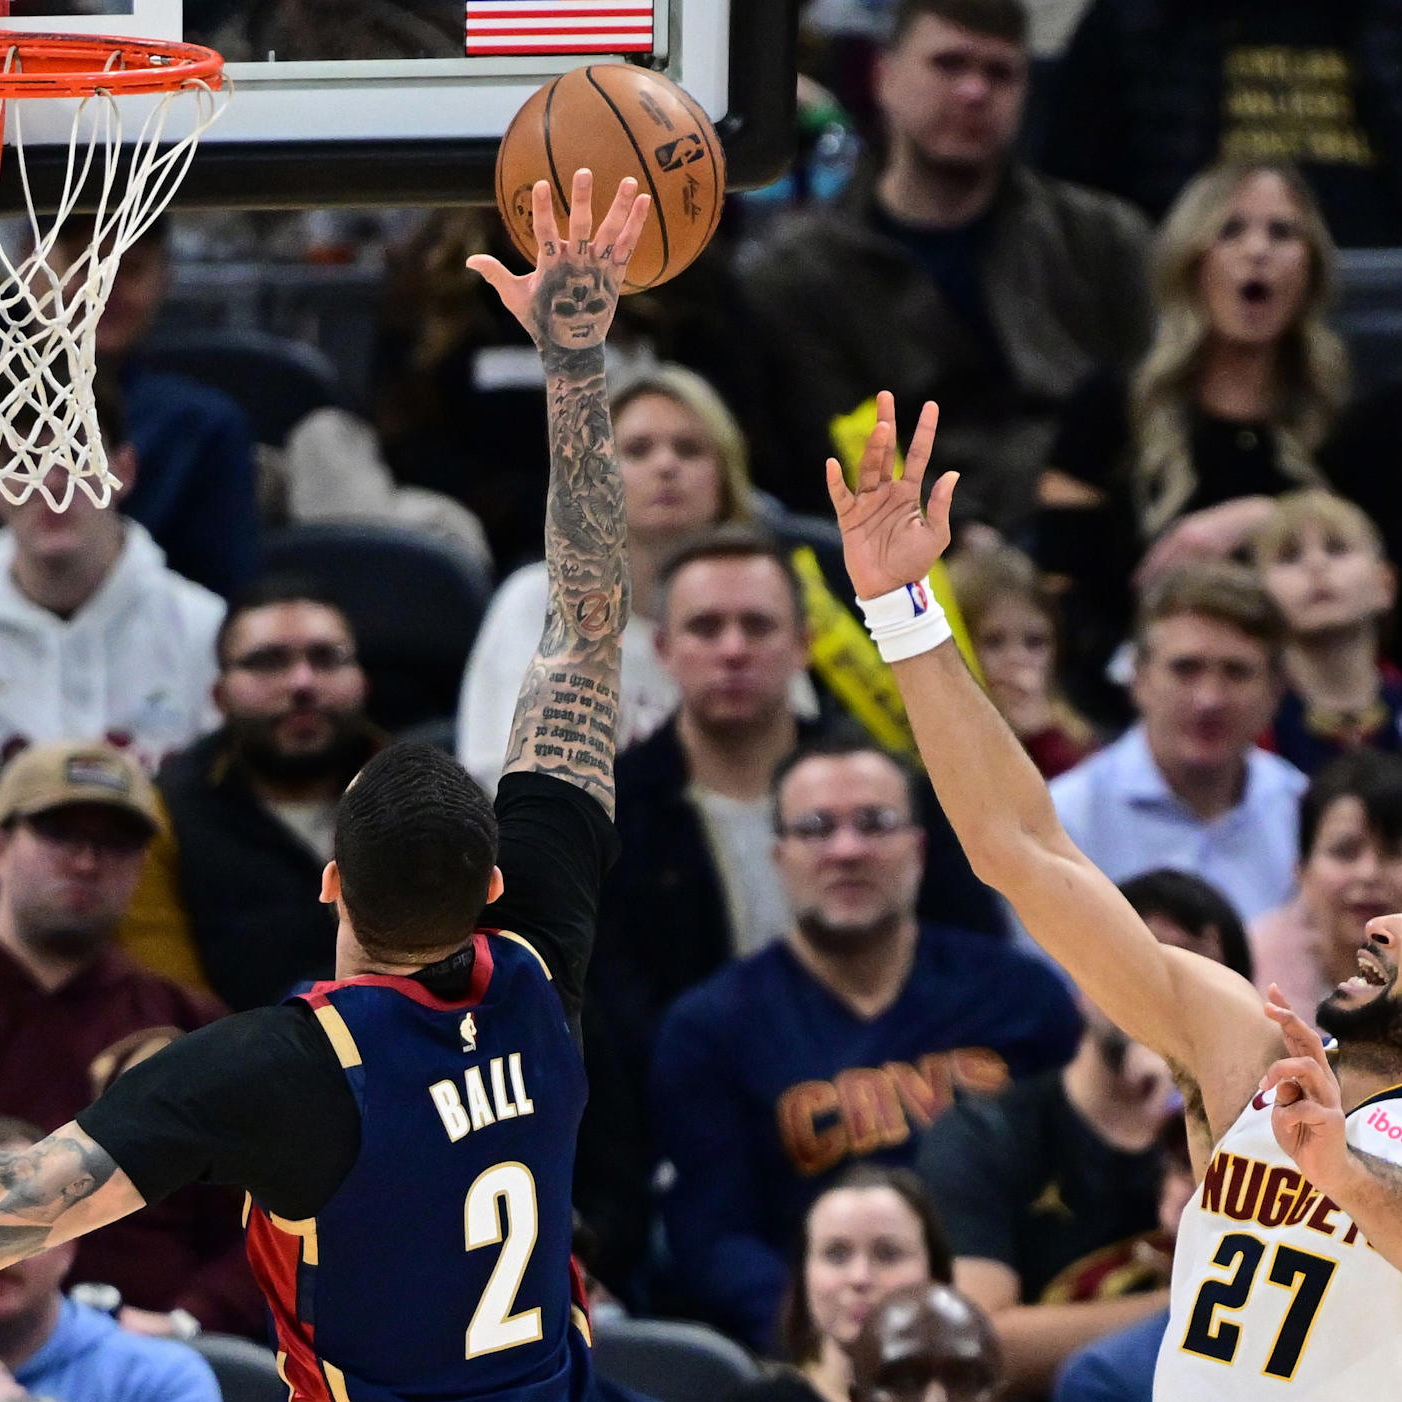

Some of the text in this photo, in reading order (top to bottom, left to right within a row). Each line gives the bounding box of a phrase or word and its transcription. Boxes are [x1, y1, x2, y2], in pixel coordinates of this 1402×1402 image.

[428, 1052, 534, 1143] BALL
[463, 1160, 543, 1360] 2
[1179, 1230, 1340, 1382] 27
